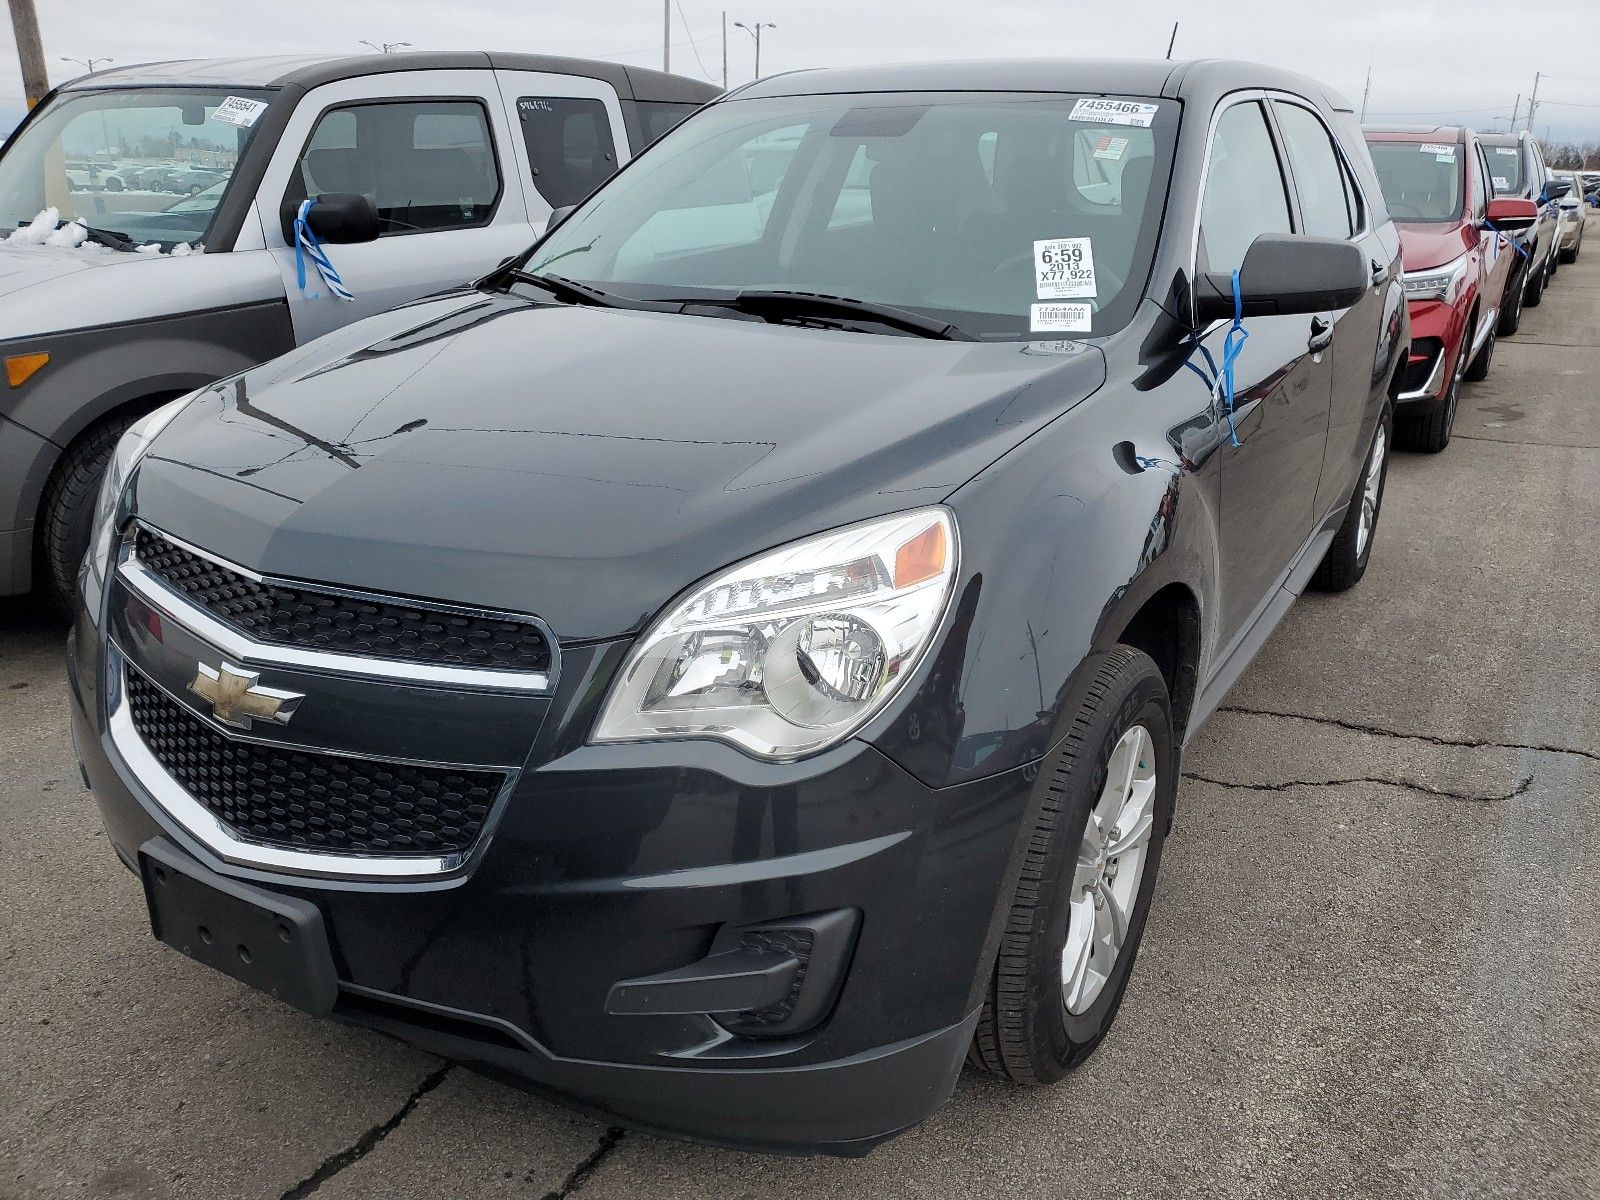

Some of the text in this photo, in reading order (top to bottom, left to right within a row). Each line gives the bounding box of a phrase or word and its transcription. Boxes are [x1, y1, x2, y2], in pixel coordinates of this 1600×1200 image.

[223, 97, 258, 112] 7455541
[1079, 100, 1140, 113] 7455466
[1042, 248, 1082, 264] 6:59
[1049, 261, 1079, 271] 2013
[1041, 269, 1092, 281] X77,922
